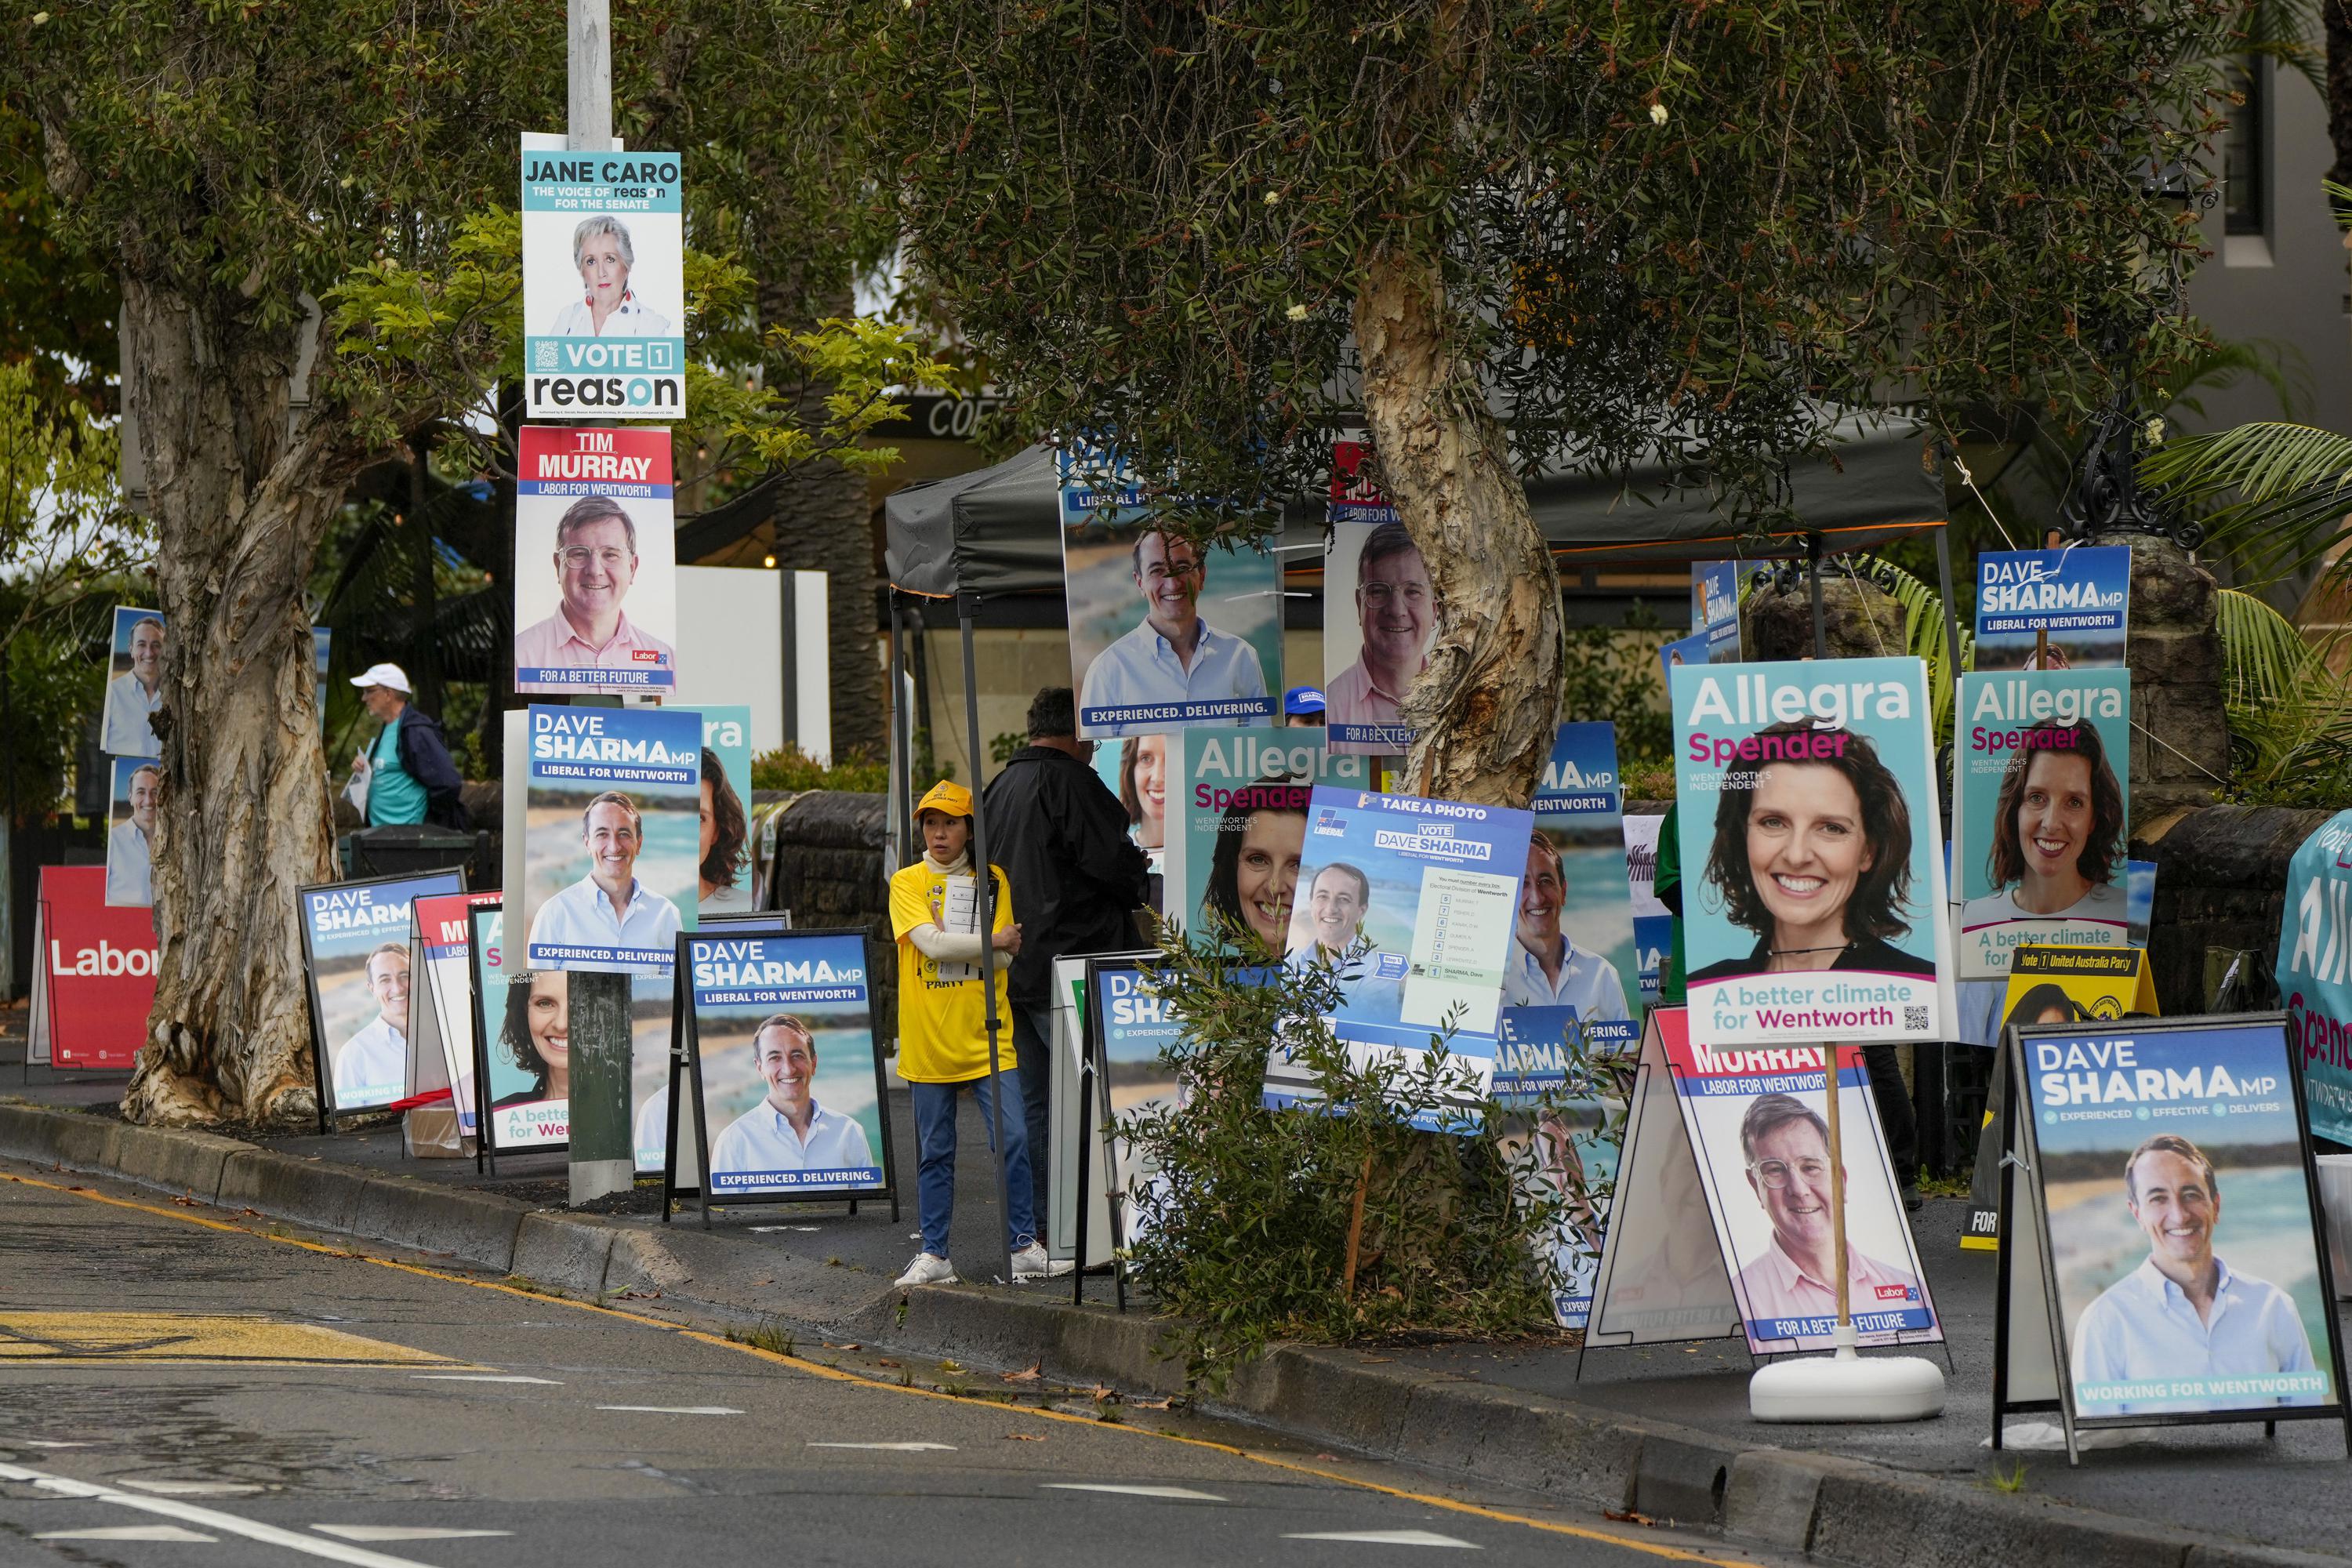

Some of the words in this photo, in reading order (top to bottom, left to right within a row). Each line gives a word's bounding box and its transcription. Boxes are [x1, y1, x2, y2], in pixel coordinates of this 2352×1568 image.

[525, 162, 594, 183] JANE
[602, 162, 678, 183] CARO
[532, 187, 554, 197] THE
[557, 187, 591, 197] VOICE
[594, 187, 610, 197] OF
[614, 186, 666, 198] reason
[555, 198, 578, 209] FOR
[581, 199, 603, 209] THE
[605, 199, 650, 210] SENATE
[565, 343, 643, 368] VOTE
[655, 349, 663, 364] 1
[534, 377, 678, 406] reason
[576, 433, 612, 452] TIM
[539, 454, 652, 481] MURRAY
[539, 483, 568, 495] LABOR
[570, 484, 589, 495] FOR
[591, 484, 651, 497] WENTWORTH
[1368, 508, 1388, 521] FOR
[1984, 561, 2043, 584] DAVE
[1706, 575, 1719, 598] DAVE
[1982, 582, 2100, 612] SHARMA
[2101, 592, 2123, 607] MP
[1708, 593, 1731, 625] SHARMA
[1987, 619, 2026, 630] LIBERAL
[2028, 618, 2047, 628] FOR
[2049, 615, 2114, 628] WENTWORTH
[540, 671, 557, 682] FOR
[560, 671, 567, 682] A
[569, 671, 607, 682] BETTER
[609, 672, 649, 684] FUTURE
[1687, 673, 1910, 731] Allegra
[1971, 681, 2122, 726] Allegra
[1091, 706, 1183, 723] EXPERIENCED.
[1186, 702, 1268, 718] DELIVERING.
[535, 713, 604, 737] DAVE
[1346, 728, 1360, 741] FOR
[1362, 728, 1367, 741] A
[1369, 728, 1411, 742] BETTER
[1971, 725, 2081, 755] Spender
[534, 735, 670, 764] SHARMA
[671, 752, 696, 765] MP
[1689, 729, 1849, 767] Spender
[1195, 737, 1360, 783] Allegra
[1970, 765, 2022, 774] INDEPENDENT
[1971, 758, 2027, 767] WENTWORTH'S
[542, 765, 586, 777] LIBERAL
[589, 766, 611, 778] FOR
[613, 769, 688, 782] WENTWORTH
[1585, 772, 1613, 788] MP
[1690, 771, 1772, 782] WENTWORTH'S
[1690, 781, 1766, 791] INDEPENDENT
[1381, 797, 1421, 813] TAKE
[1421, 803, 1432, 814] A
[1435, 804, 1487, 820] PHOTO
[1530, 797, 1606, 811] WENTWORTH
[1195, 816, 1258, 825] WENTWORTH'S
[1314, 826, 1344, 837] LIBERAL
[1420, 826, 1452, 836] VOTE
[1378, 833, 1417, 848] DAVE
[1419, 838, 1487, 858] SHARMA
[1429, 855, 1464, 863] WENTWORTH
[313, 890, 372, 912] DAVE
[315, 902, 411, 931] SHARM
[326, 930, 370, 940] EXPERIENCED
[382, 924, 411, 934] EFFECTIV
[1979, 932, 1991, 947] A
[1996, 930, 2046, 947] better
[2051, 928, 2111, 945] climate
[446, 946, 469, 957] LABO
[538, 947, 614, 960] EXPERIENCED.
[617, 949, 674, 963] DELIVERIN
[693, 942, 765, 962] DAVE
[1984, 950, 2008, 966] for
[2021, 953, 2038, 967] Vote
[2042, 955, 2047, 966] 1
[2049, 954, 2075, 967] United
[2075, 955, 2110, 969] Australia
[2110, 956, 2131, 971] Party
[695, 960, 837, 987] SHARMA
[837, 969, 862, 982] MP
[705, 990, 751, 1004] LIBERAL
[753, 990, 777, 1002] FOR
[780, 989, 857, 1001] WENTWORTH
[1713, 988, 1731, 1007] A
[1739, 985, 1814, 1007] better
[1822, 982, 1911, 1004] climate
[2099, 999, 2117, 1010] AUSTRALIA
[1714, 1010, 1748, 1030] for
[1756, 1006, 1893, 1029] Wentworth
[1284, 1047, 1291, 1059] 1
[2037, 1040, 2137, 1071] DAVE
[339, 1087, 390, 1099] WORKING
[393, 1085, 405, 1094] FO
[1521, 1079, 1537, 1092] FOR
[1701, 1079, 1737, 1095] LABOR
[1740, 1078, 1762, 1094] FOR
[1763, 1073, 1839, 1092] WENTWORT
[2040, 1065, 2241, 1106] SHARMA
[2241, 1076, 2276, 1096] MP
[509, 1111, 521, 1123] A
[526, 1109, 568, 1123] bette
[2060, 1109, 2132, 1122] EXPERIENCED
[2152, 1105, 2209, 1117] EFFECTIVE
[2229, 1102, 2280, 1114] DELIVERS
[510, 1126, 532, 1138] for
[720, 1173, 800, 1185] EXPERIENCED.
[803, 1171, 874, 1184] DELIVERING.
[1972, 1211, 1998, 1233] FOR
[1877, 1288, 1904, 1298] Labor
[1775, 1320, 1800, 1335] FOR
[1802, 1319, 1811, 1334] A
[1811, 1318, 1855, 1334] BETT
[1857, 1313, 1907, 1331] FUTURE
[2082, 1383, 2166, 1402] WORKING
[2171, 1380, 2205, 1399] FOR
[2209, 1376, 2323, 1396] WENTWORTH
